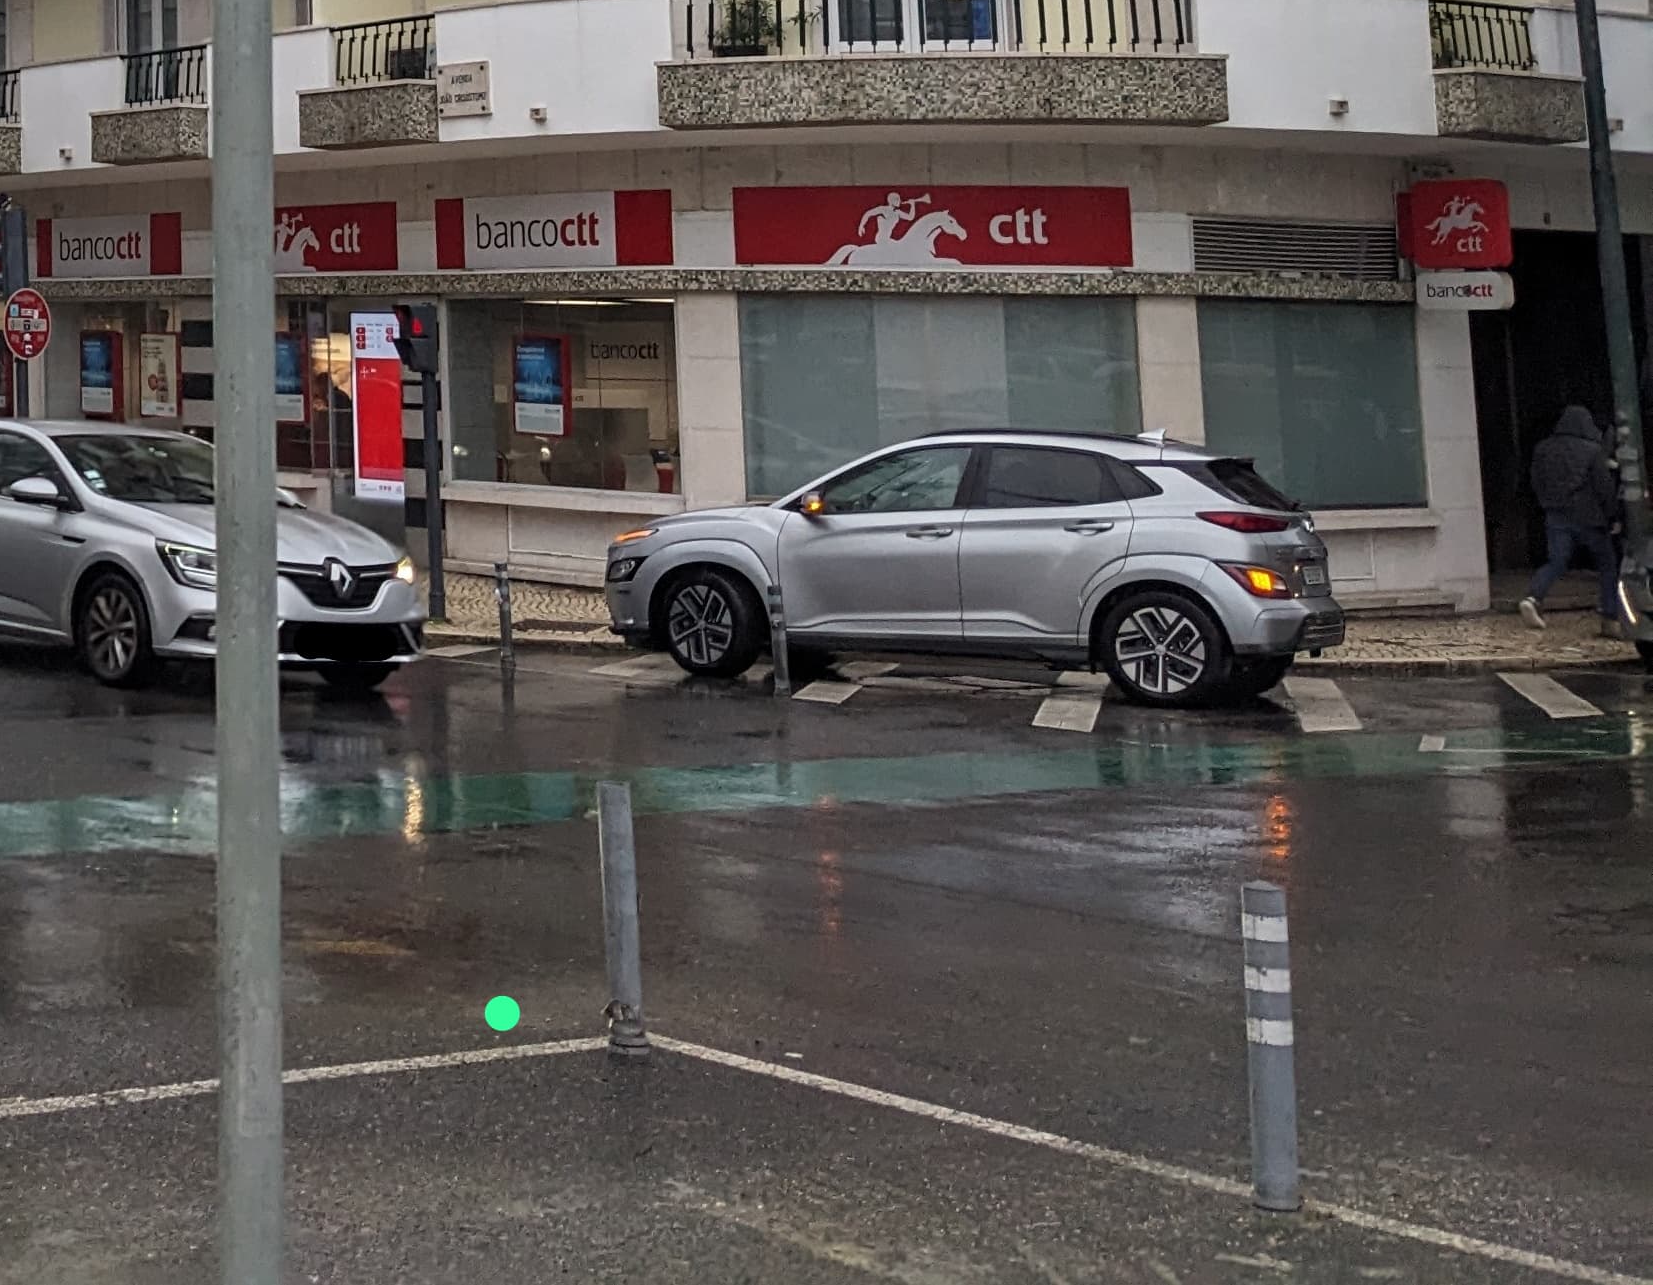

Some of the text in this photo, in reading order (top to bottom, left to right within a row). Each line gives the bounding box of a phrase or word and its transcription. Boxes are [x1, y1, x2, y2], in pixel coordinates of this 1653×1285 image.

[330, 222, 360, 253] ctt
[475, 211, 600, 249] bancoctt
[989, 207, 1048, 244] ctt
[59, 231, 141, 261] bancoctt
[1456, 235, 1483, 253] ctt
